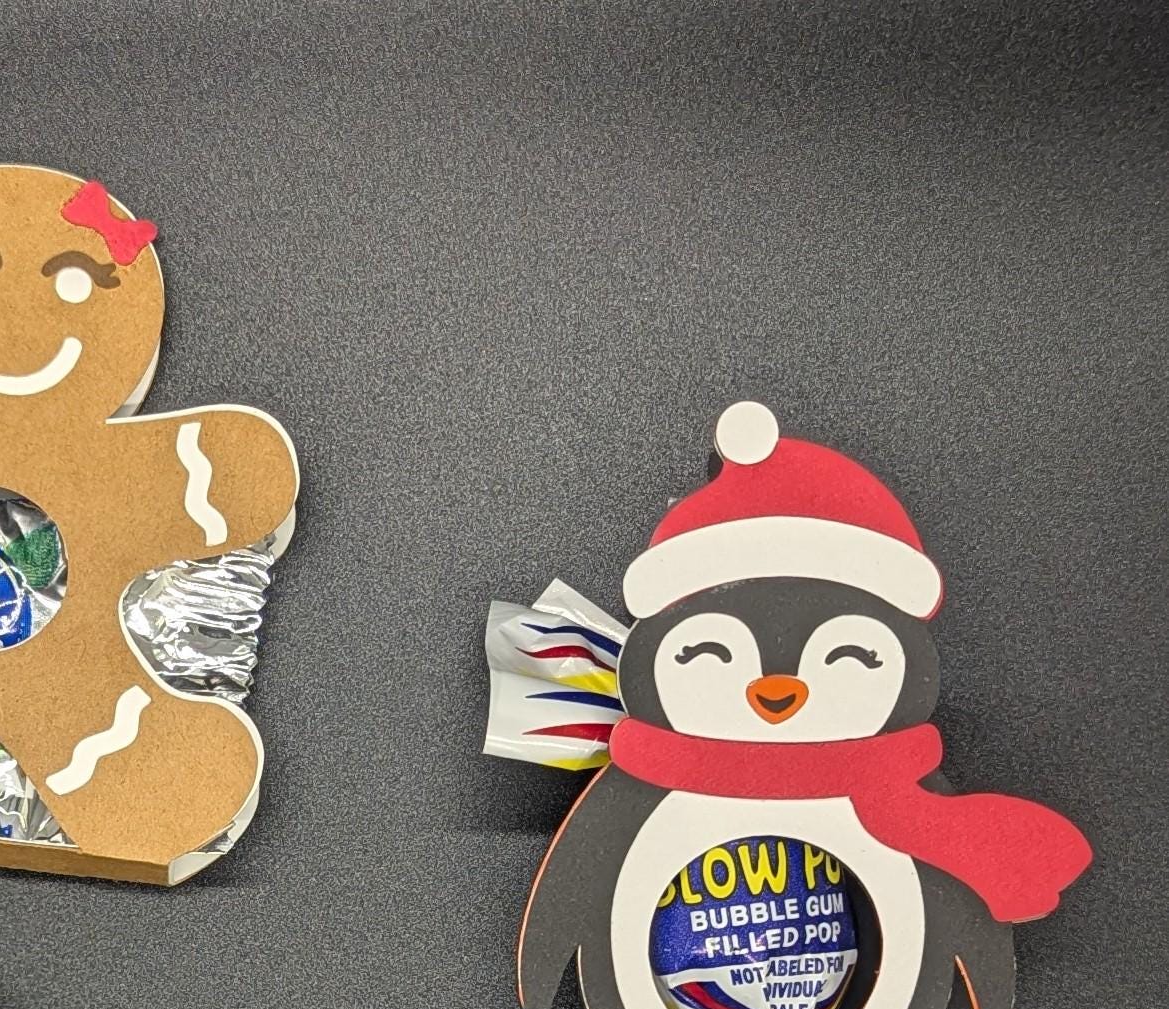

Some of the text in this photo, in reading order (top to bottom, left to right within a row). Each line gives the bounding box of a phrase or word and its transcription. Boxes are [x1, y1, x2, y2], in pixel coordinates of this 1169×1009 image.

[690, 892, 843, 932] BUBBLE GUM
[704, 921, 841, 958] FILLED POP
[730, 967, 763, 985] NOT
[766, 957, 824, 976] ABELED
